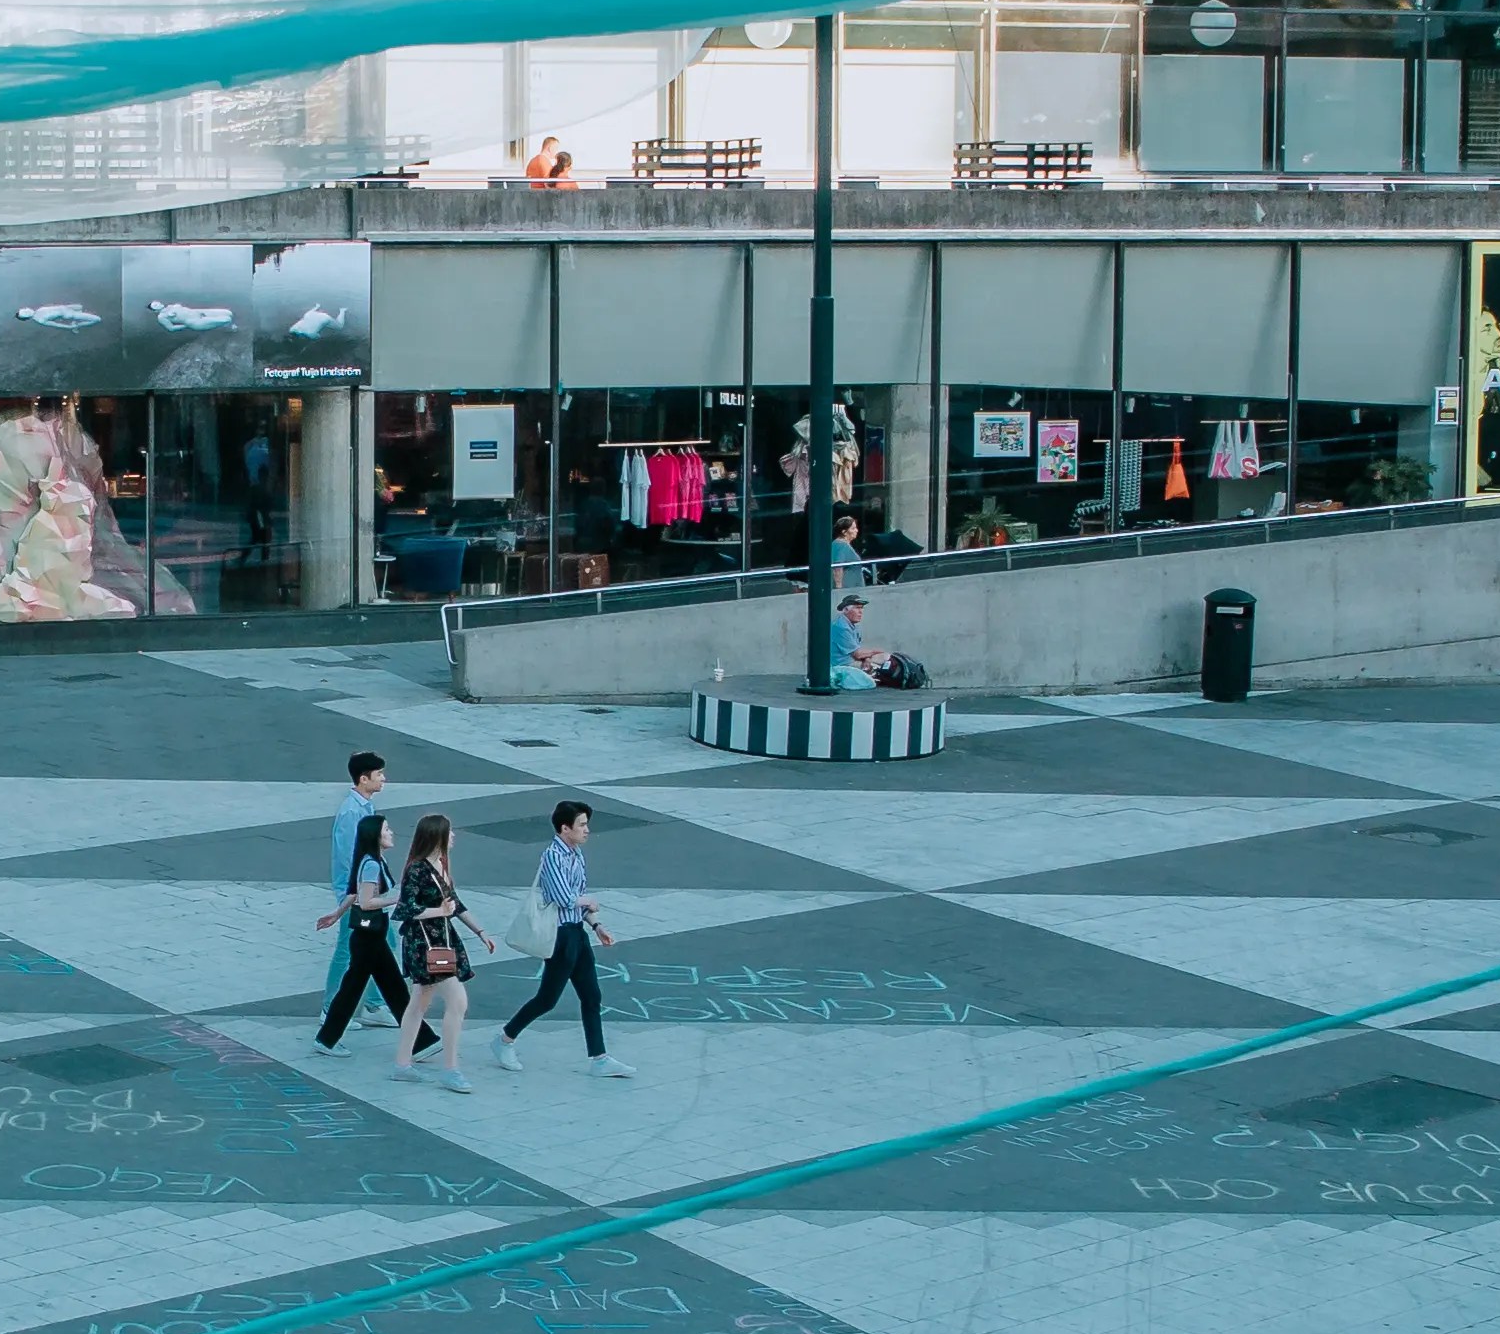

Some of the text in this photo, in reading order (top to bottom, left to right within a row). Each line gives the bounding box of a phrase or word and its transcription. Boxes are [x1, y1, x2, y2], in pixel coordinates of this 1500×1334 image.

[65, 1110, 206, 1136] GÖR
[1039, 1123, 1197, 1164] VEGAN
[22, 1163, 264, 1196] VEGO
[334, 1172, 547, 1204] VÄLJ
[1129, 1177, 1279, 1201] OCH
[485, 1267, 592, 1288] IS
[489, 1286, 691, 1314] DAIRY
